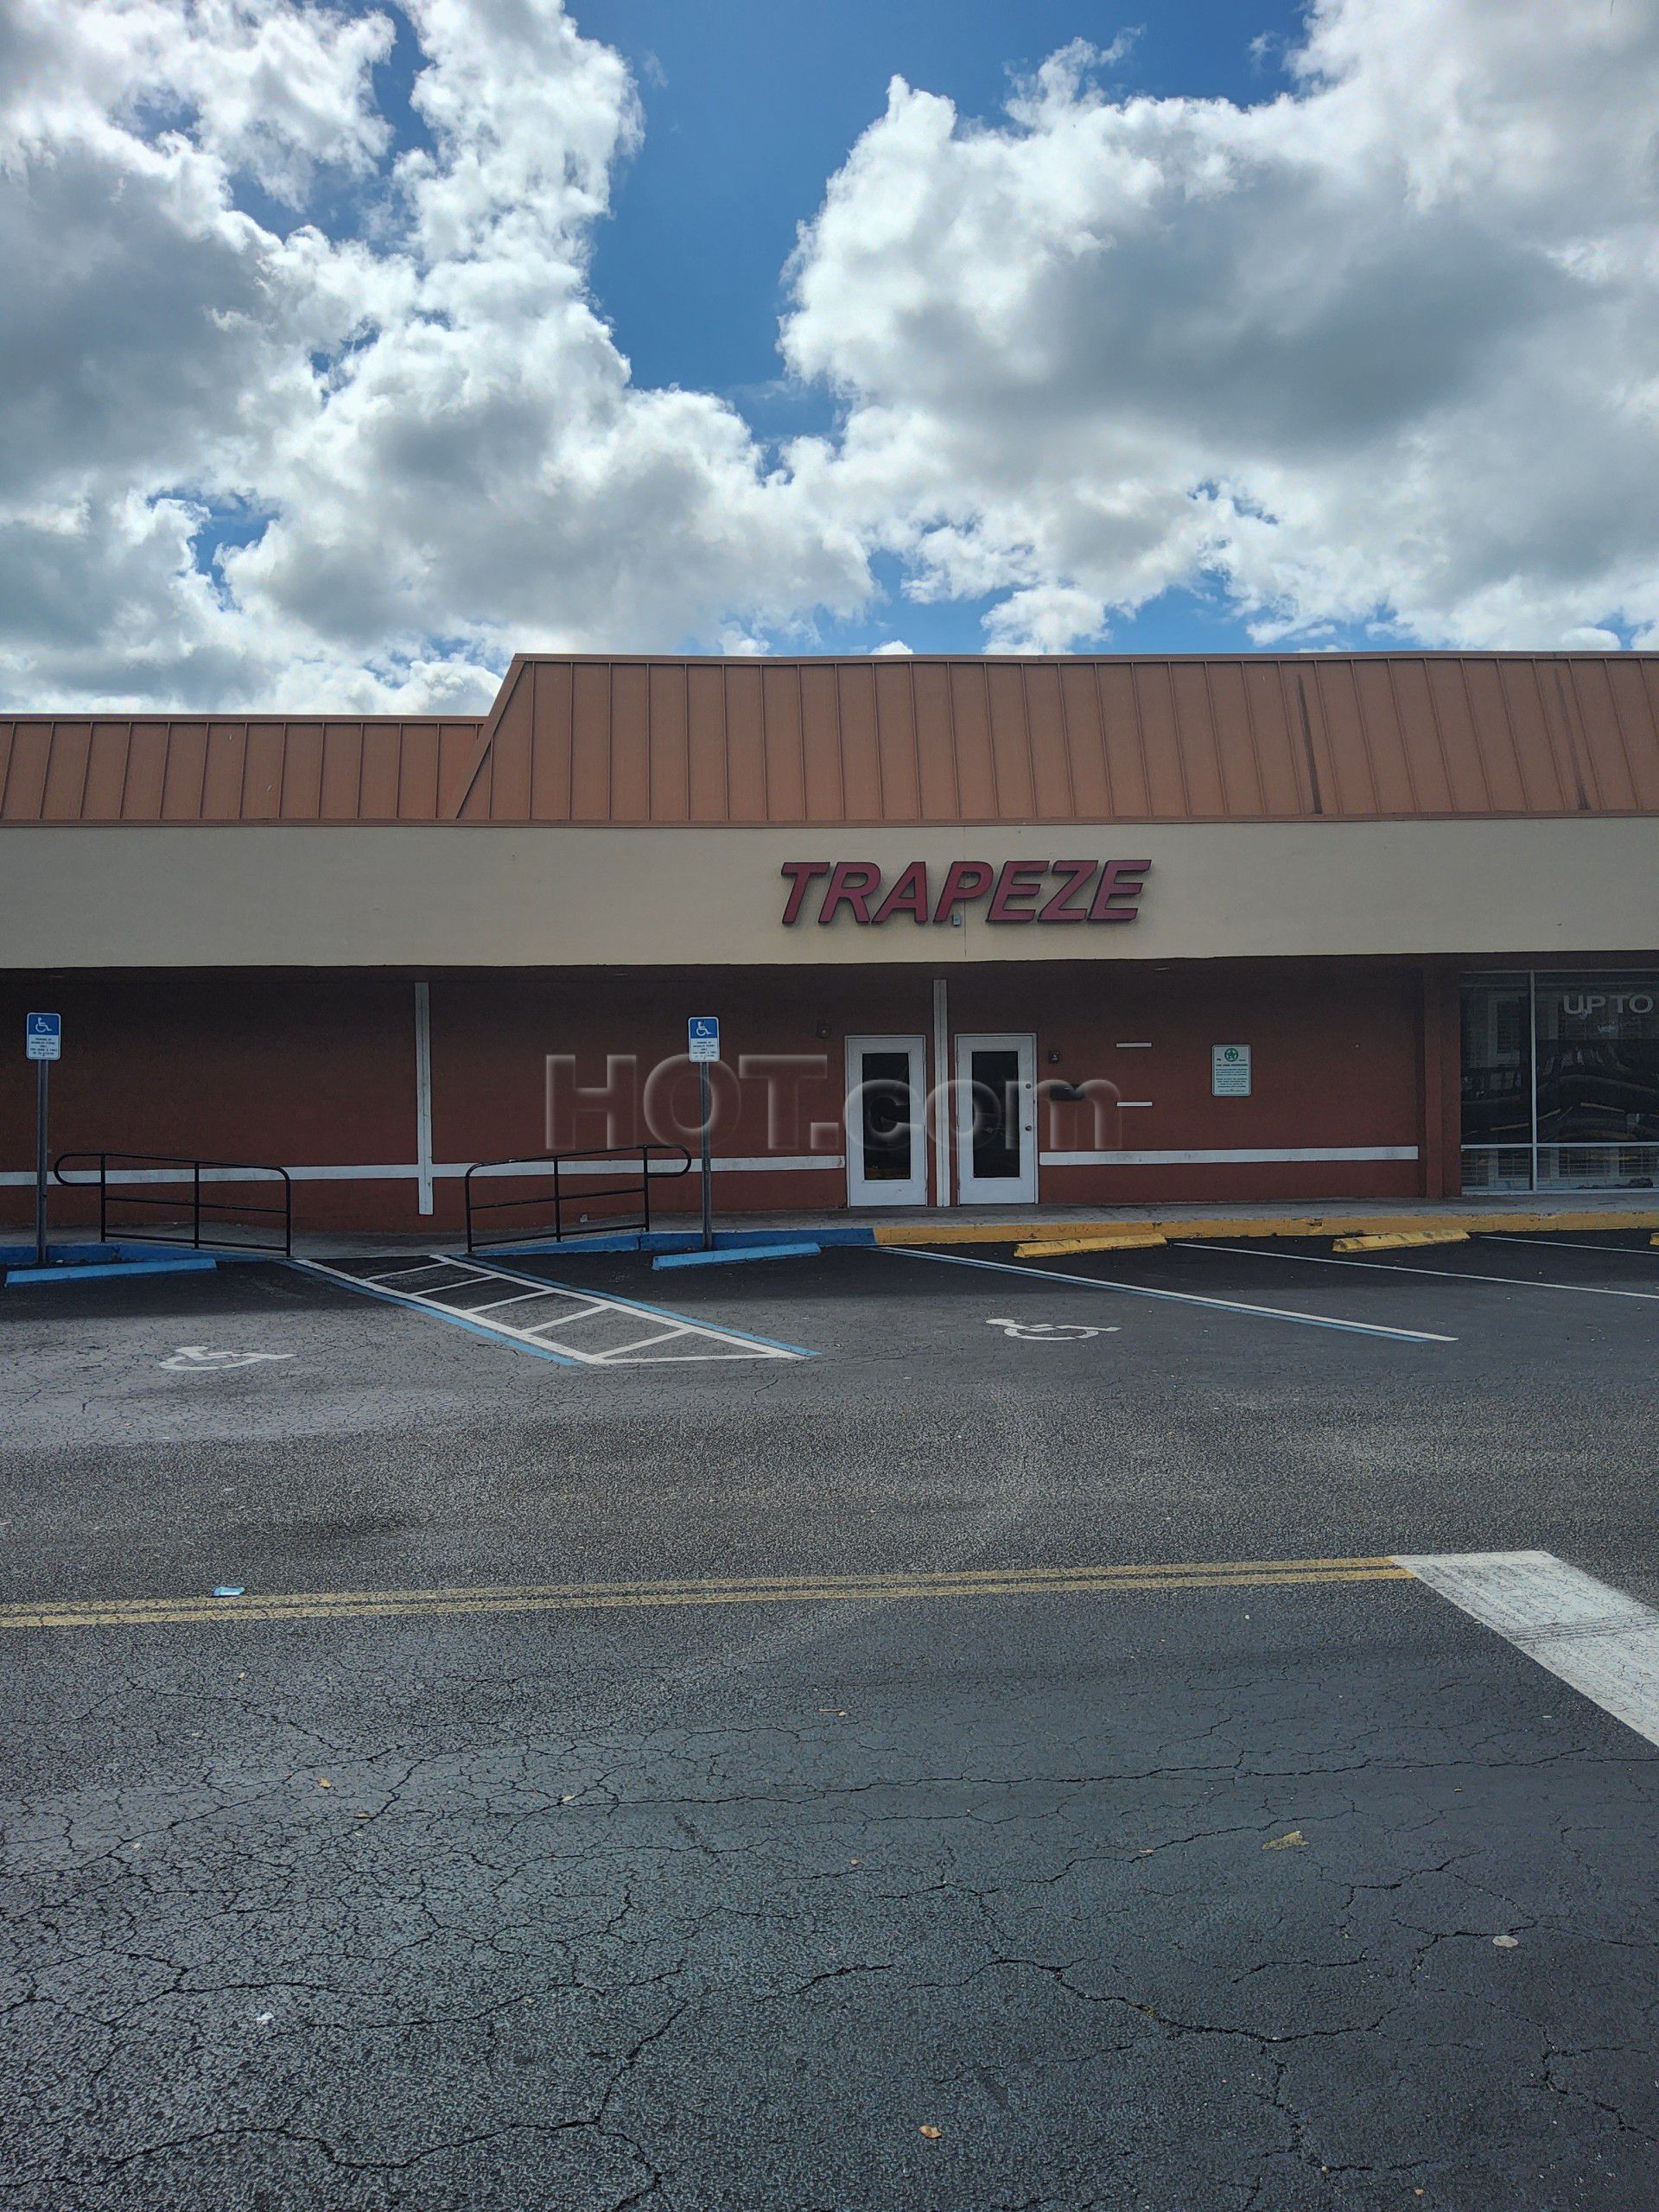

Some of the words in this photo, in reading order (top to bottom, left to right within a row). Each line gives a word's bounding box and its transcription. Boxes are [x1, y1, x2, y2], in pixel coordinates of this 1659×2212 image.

[780, 859, 1152, 924] TRAPEZE
[1563, 995, 1606, 1014] UP
[1609, 994, 1654, 1014] TO
